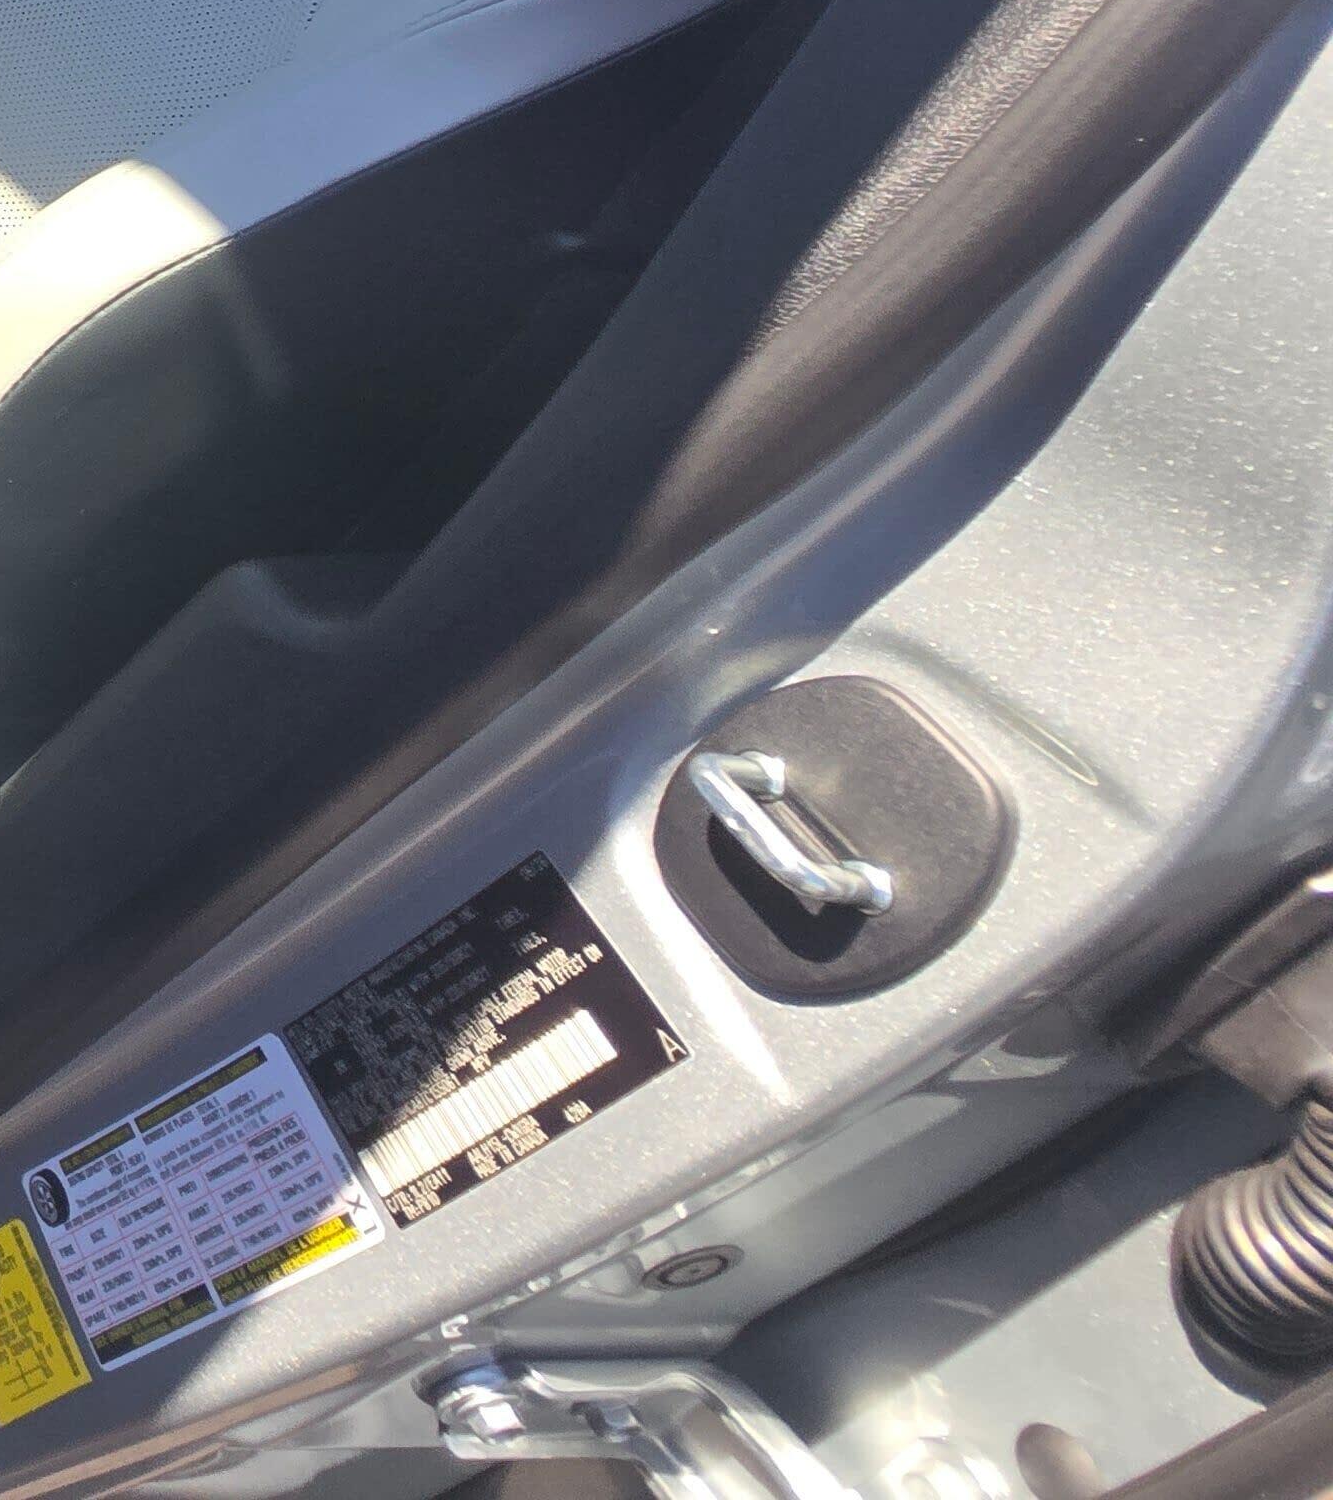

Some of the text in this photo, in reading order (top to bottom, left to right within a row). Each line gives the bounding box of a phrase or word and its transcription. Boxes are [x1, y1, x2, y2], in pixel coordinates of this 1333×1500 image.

[488, 983, 540, 1024] STANDARDS
[548, 953, 586, 985] EFFECT
[500, 968, 540, 1000] FEDERAL
[655, 1028, 687, 1062] A
